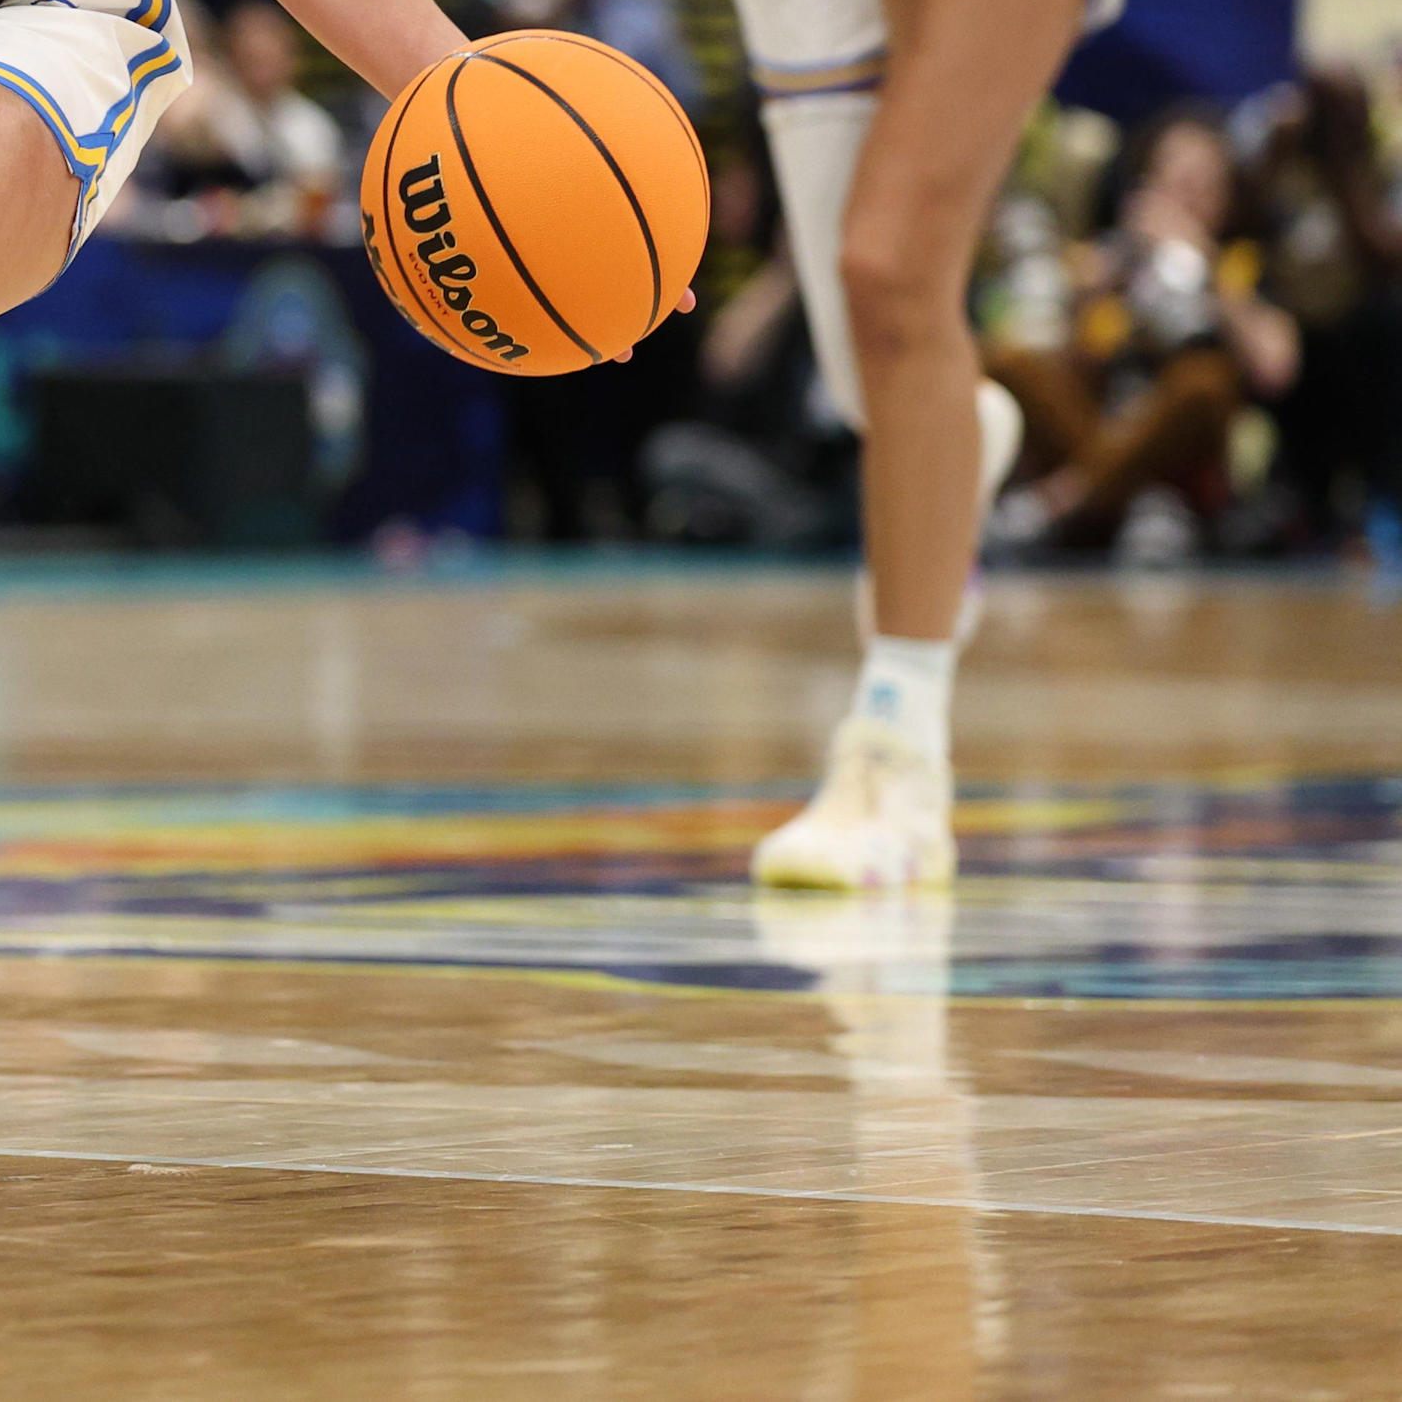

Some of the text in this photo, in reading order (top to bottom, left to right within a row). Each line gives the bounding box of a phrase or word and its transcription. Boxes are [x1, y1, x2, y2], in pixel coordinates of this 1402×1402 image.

[399, 151, 531, 363] Wilson
[409, 252, 450, 316] EVO NXT
